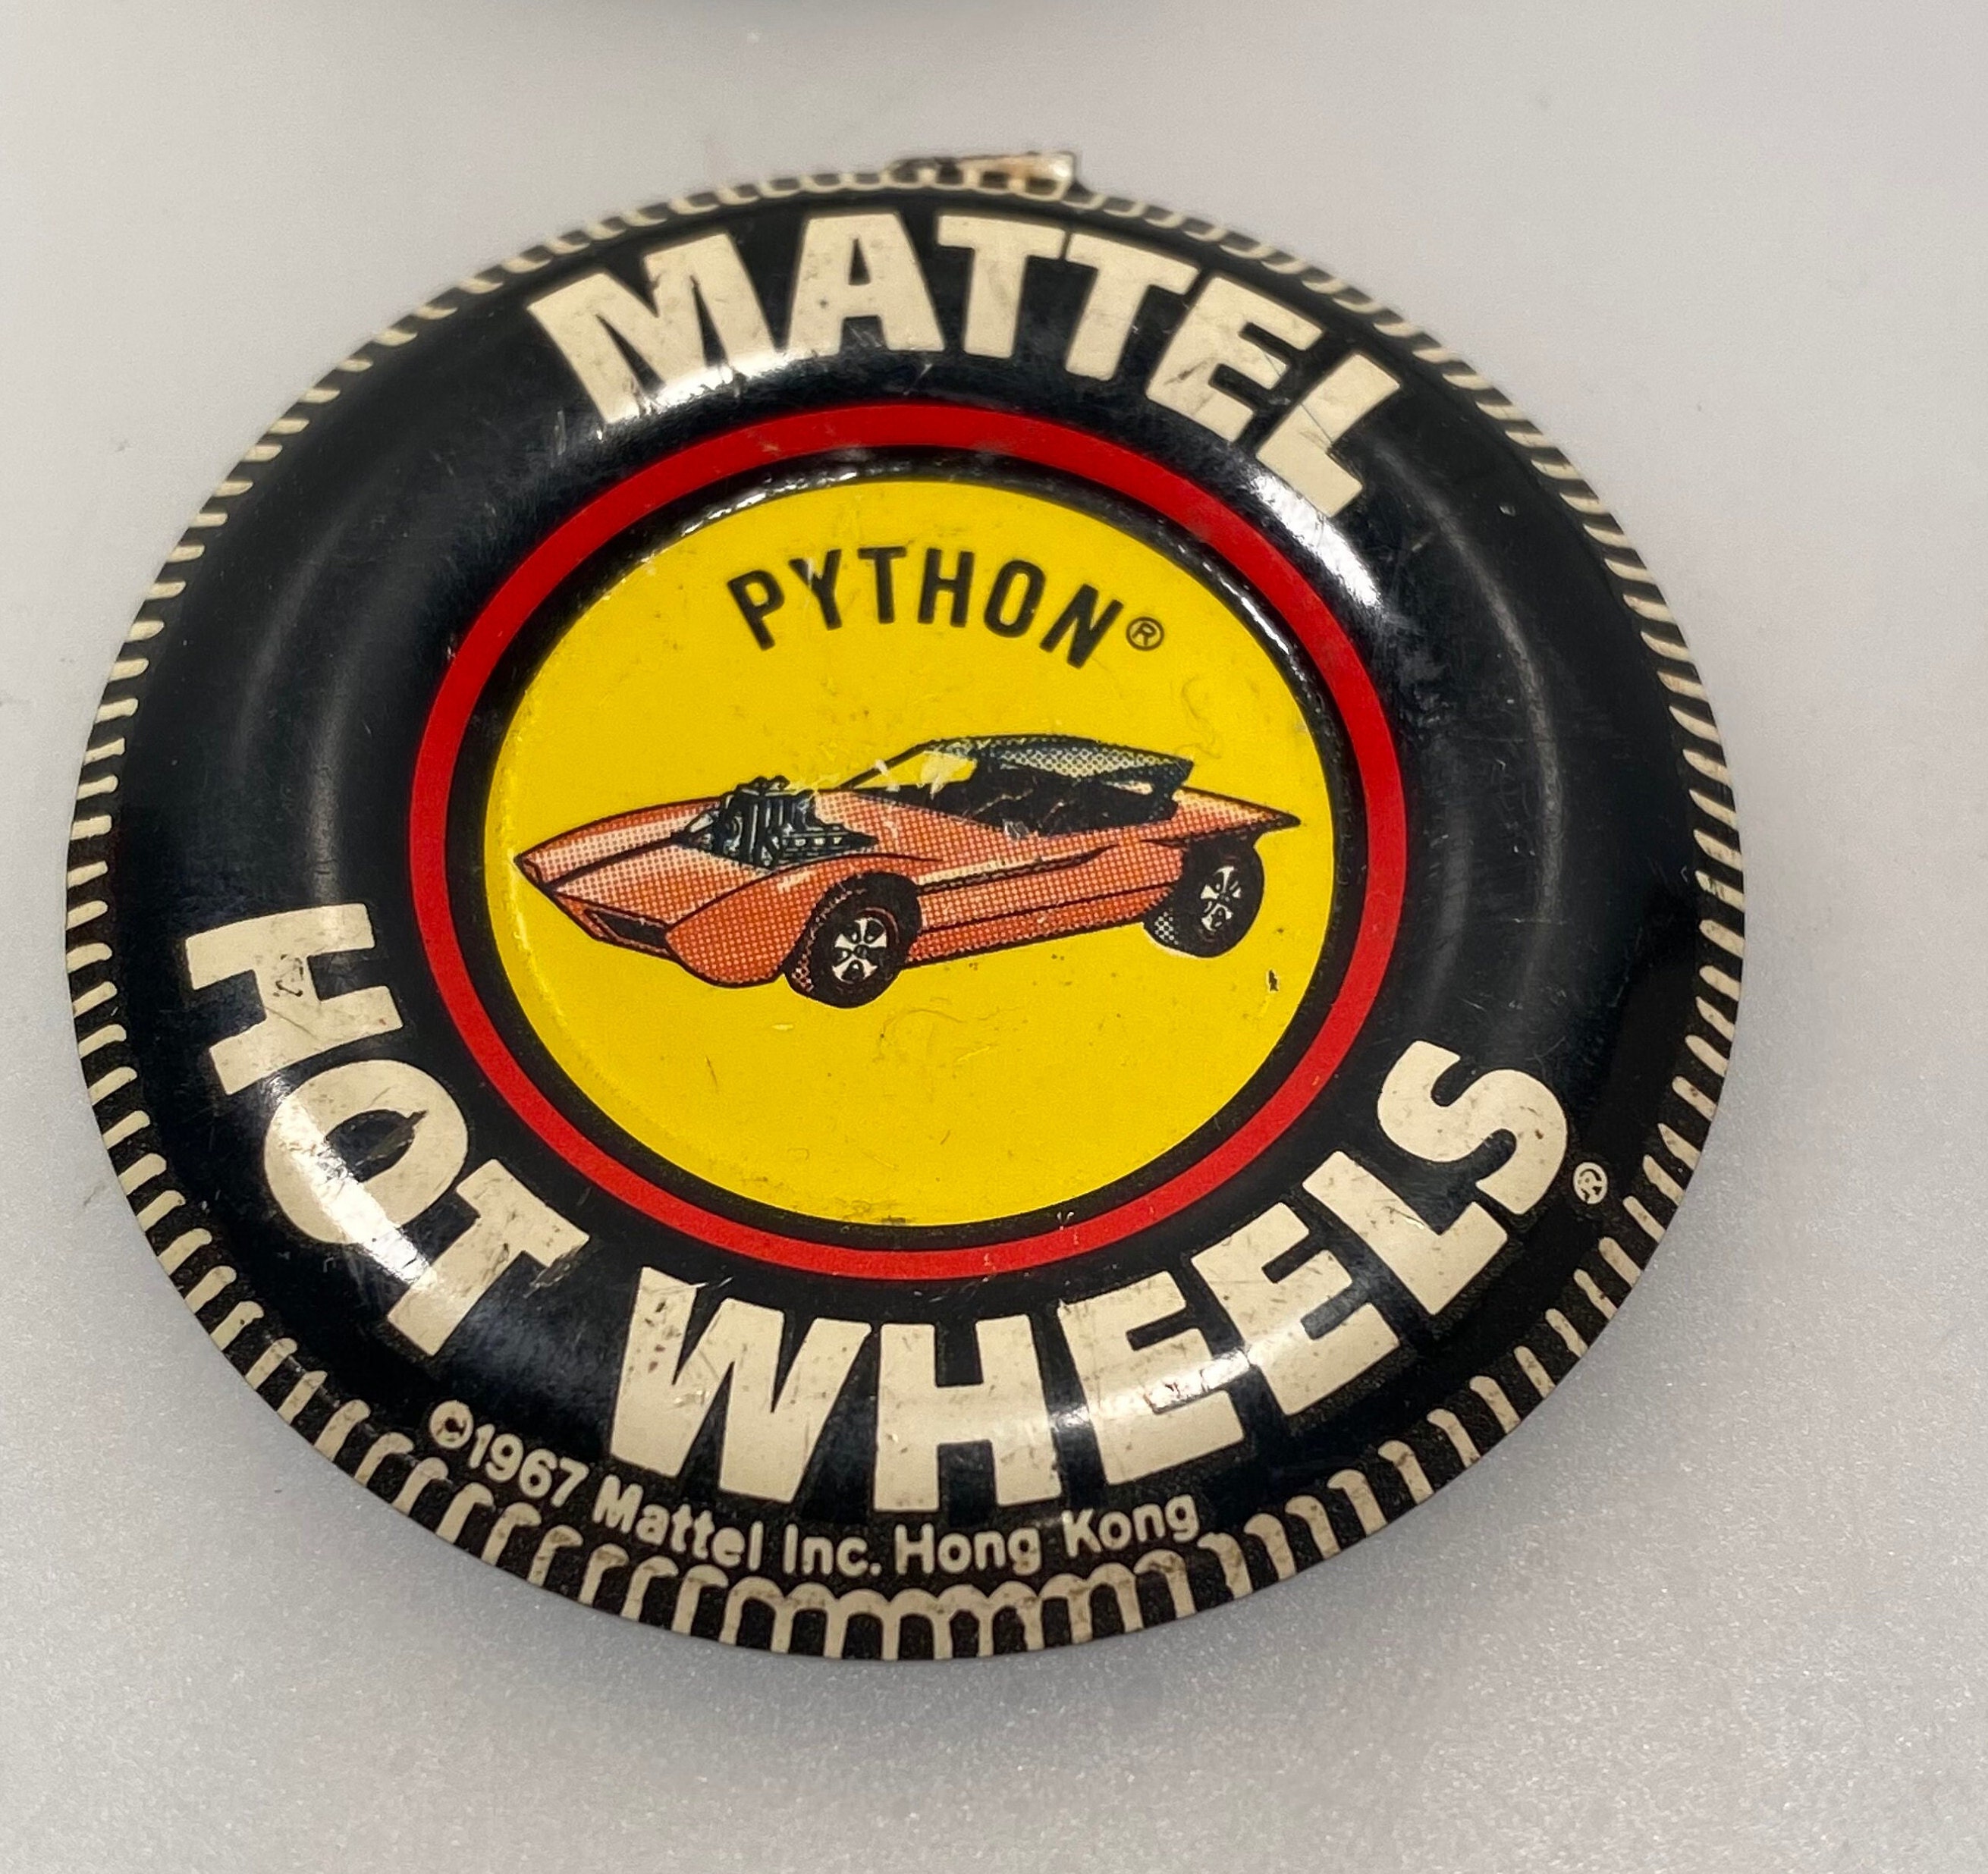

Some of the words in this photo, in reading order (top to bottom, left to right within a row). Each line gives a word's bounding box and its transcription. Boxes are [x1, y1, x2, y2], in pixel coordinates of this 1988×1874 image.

[528, 212, 1399, 517] MATTEL
[186, 902, 589, 1356] HOT
[429, 1400, 589, 1507] ©1967
[593, 1474, 764, 1570] Mattel
[783, 1523, 882, 1578] Inc.
[895, 1523, 1042, 1576] Hong
[1062, 1494, 1201, 1559] Kong
